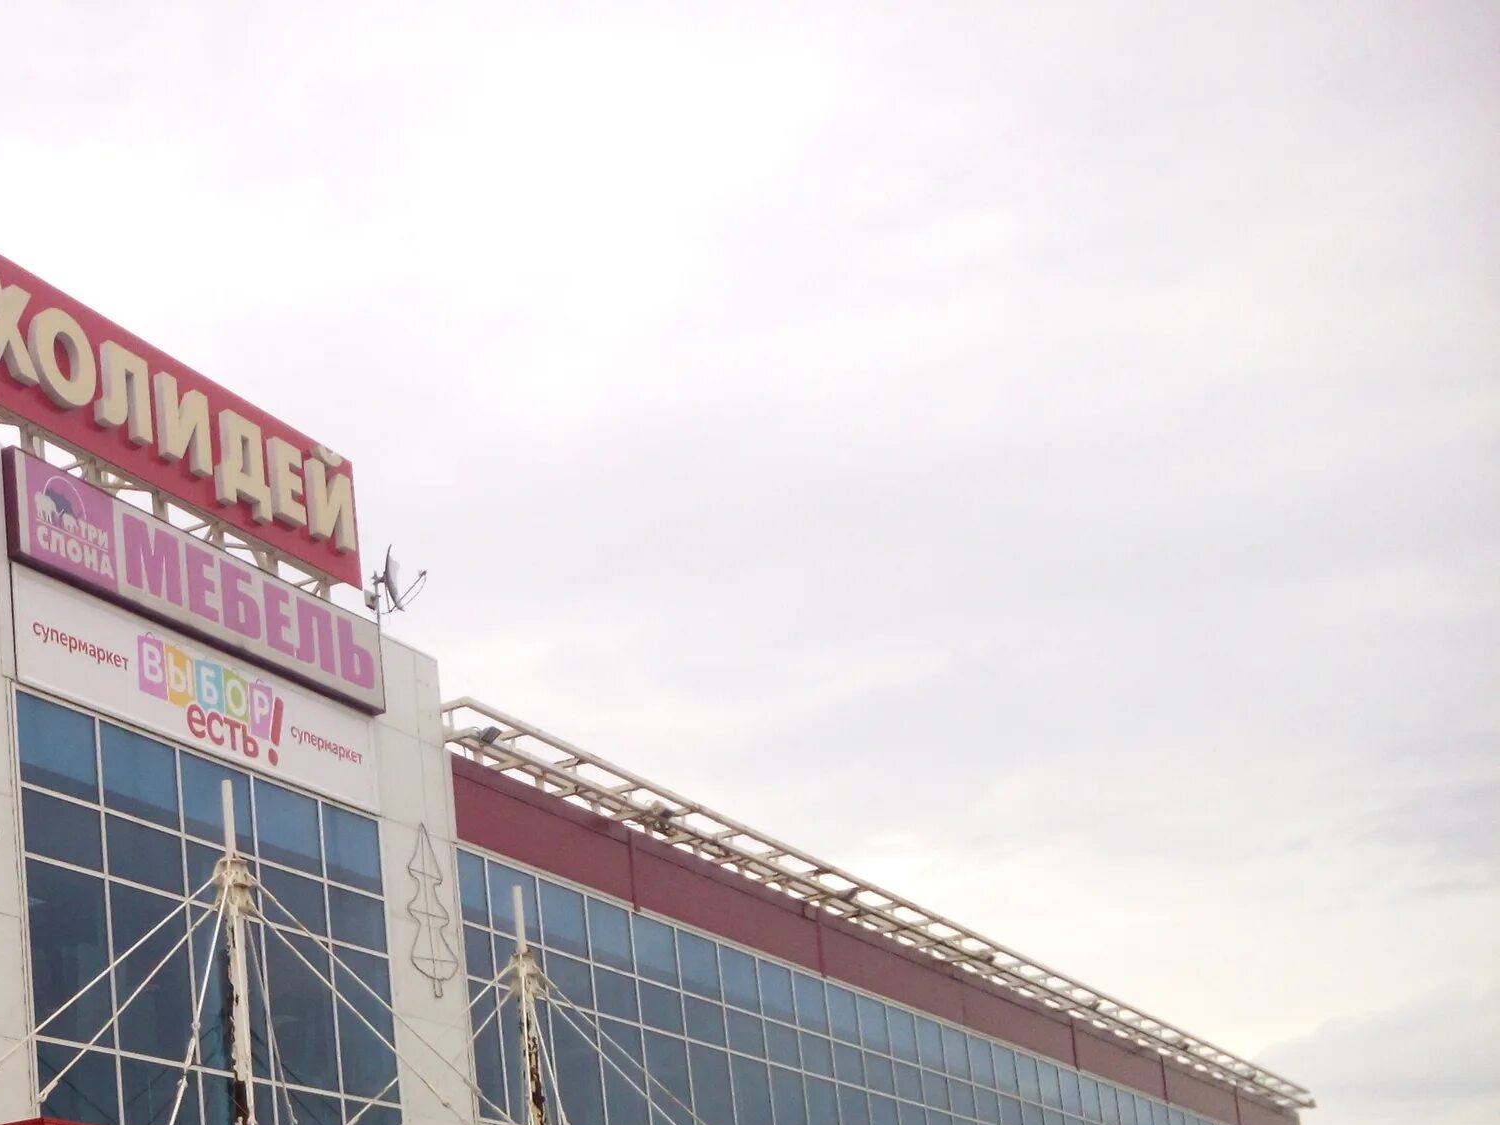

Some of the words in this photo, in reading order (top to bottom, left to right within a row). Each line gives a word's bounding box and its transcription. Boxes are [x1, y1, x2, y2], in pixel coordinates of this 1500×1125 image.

[36, 526, 115, 580] СЛОНА
[80, 523, 109, 548] ТРИ
[122, 512, 375, 690] МЕБЕЛЬ
[33, 621, 129, 671] супермаркет
[141, 639, 272, 733] ВЫБОР
[290, 723, 363, 765] супермаркет
